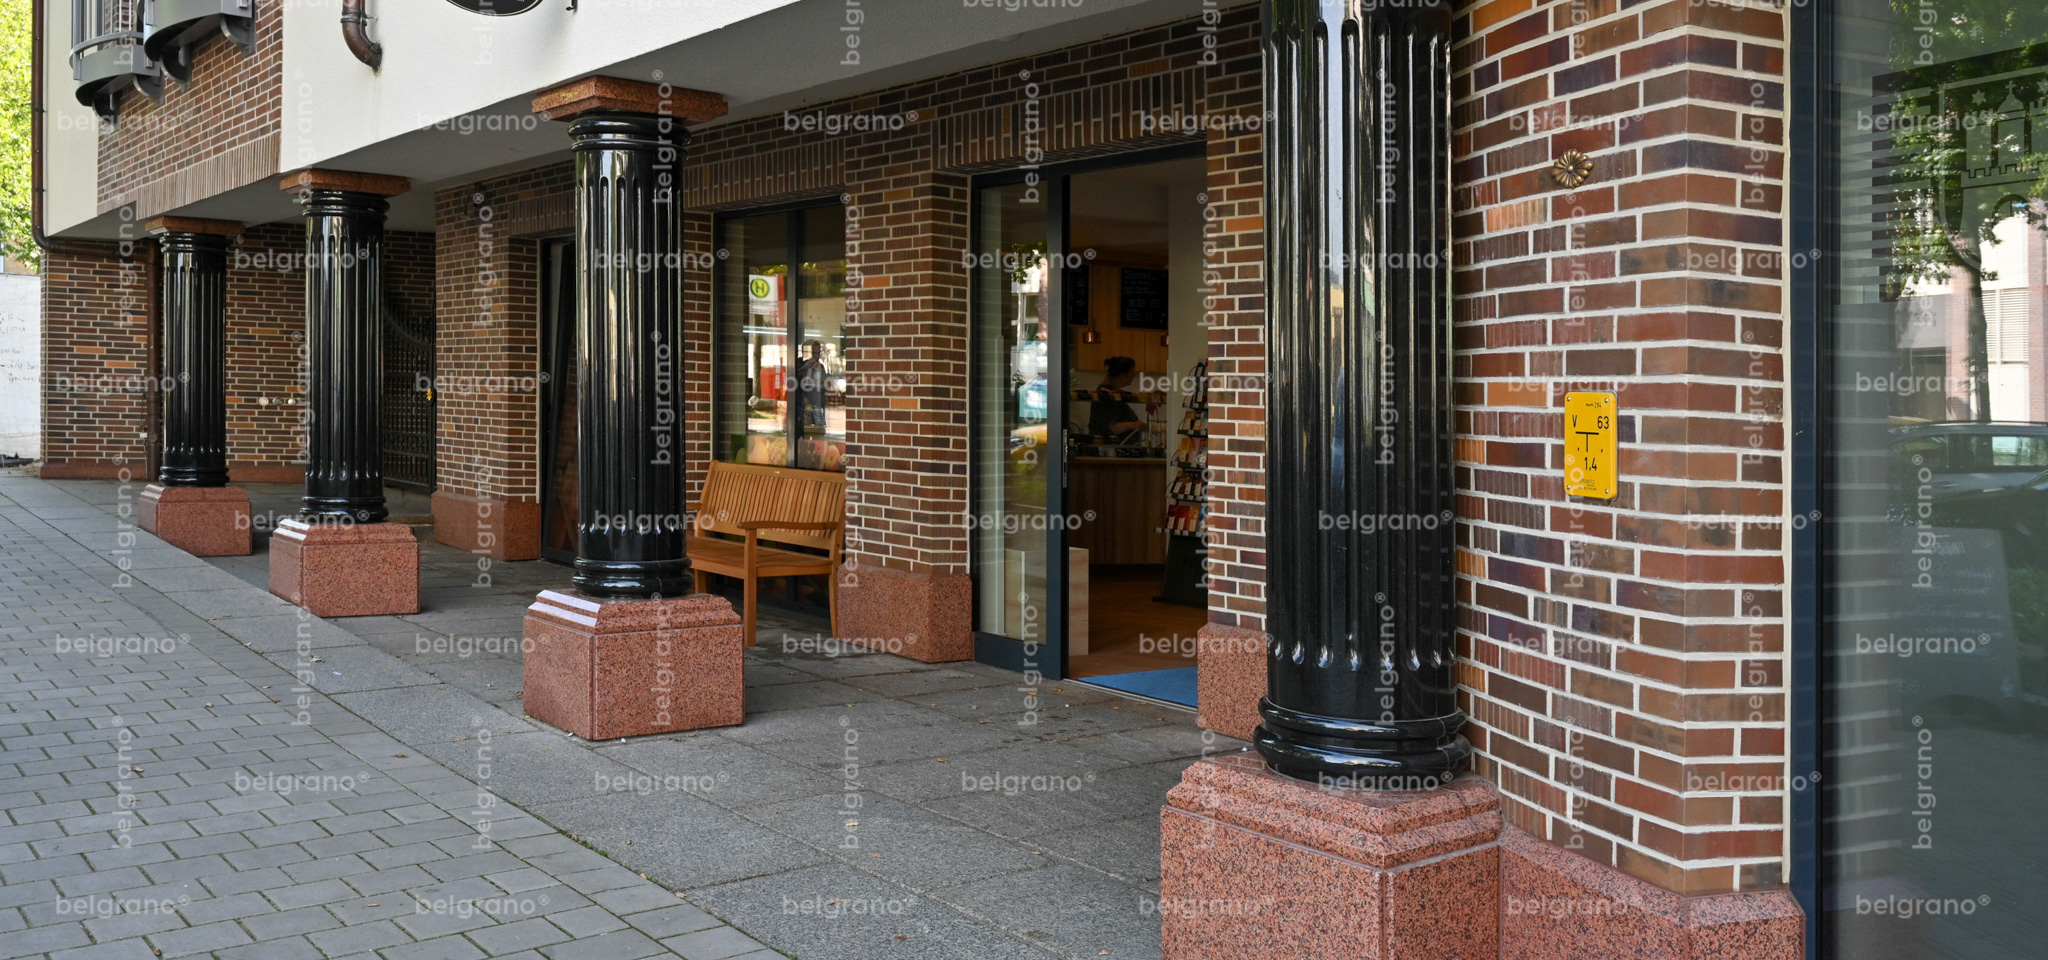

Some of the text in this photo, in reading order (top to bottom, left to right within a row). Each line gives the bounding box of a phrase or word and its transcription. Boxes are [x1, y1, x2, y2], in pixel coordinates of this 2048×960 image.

[1572, 414, 1610, 429] V 63
[1584, 457, 1598, 471] 1,4
